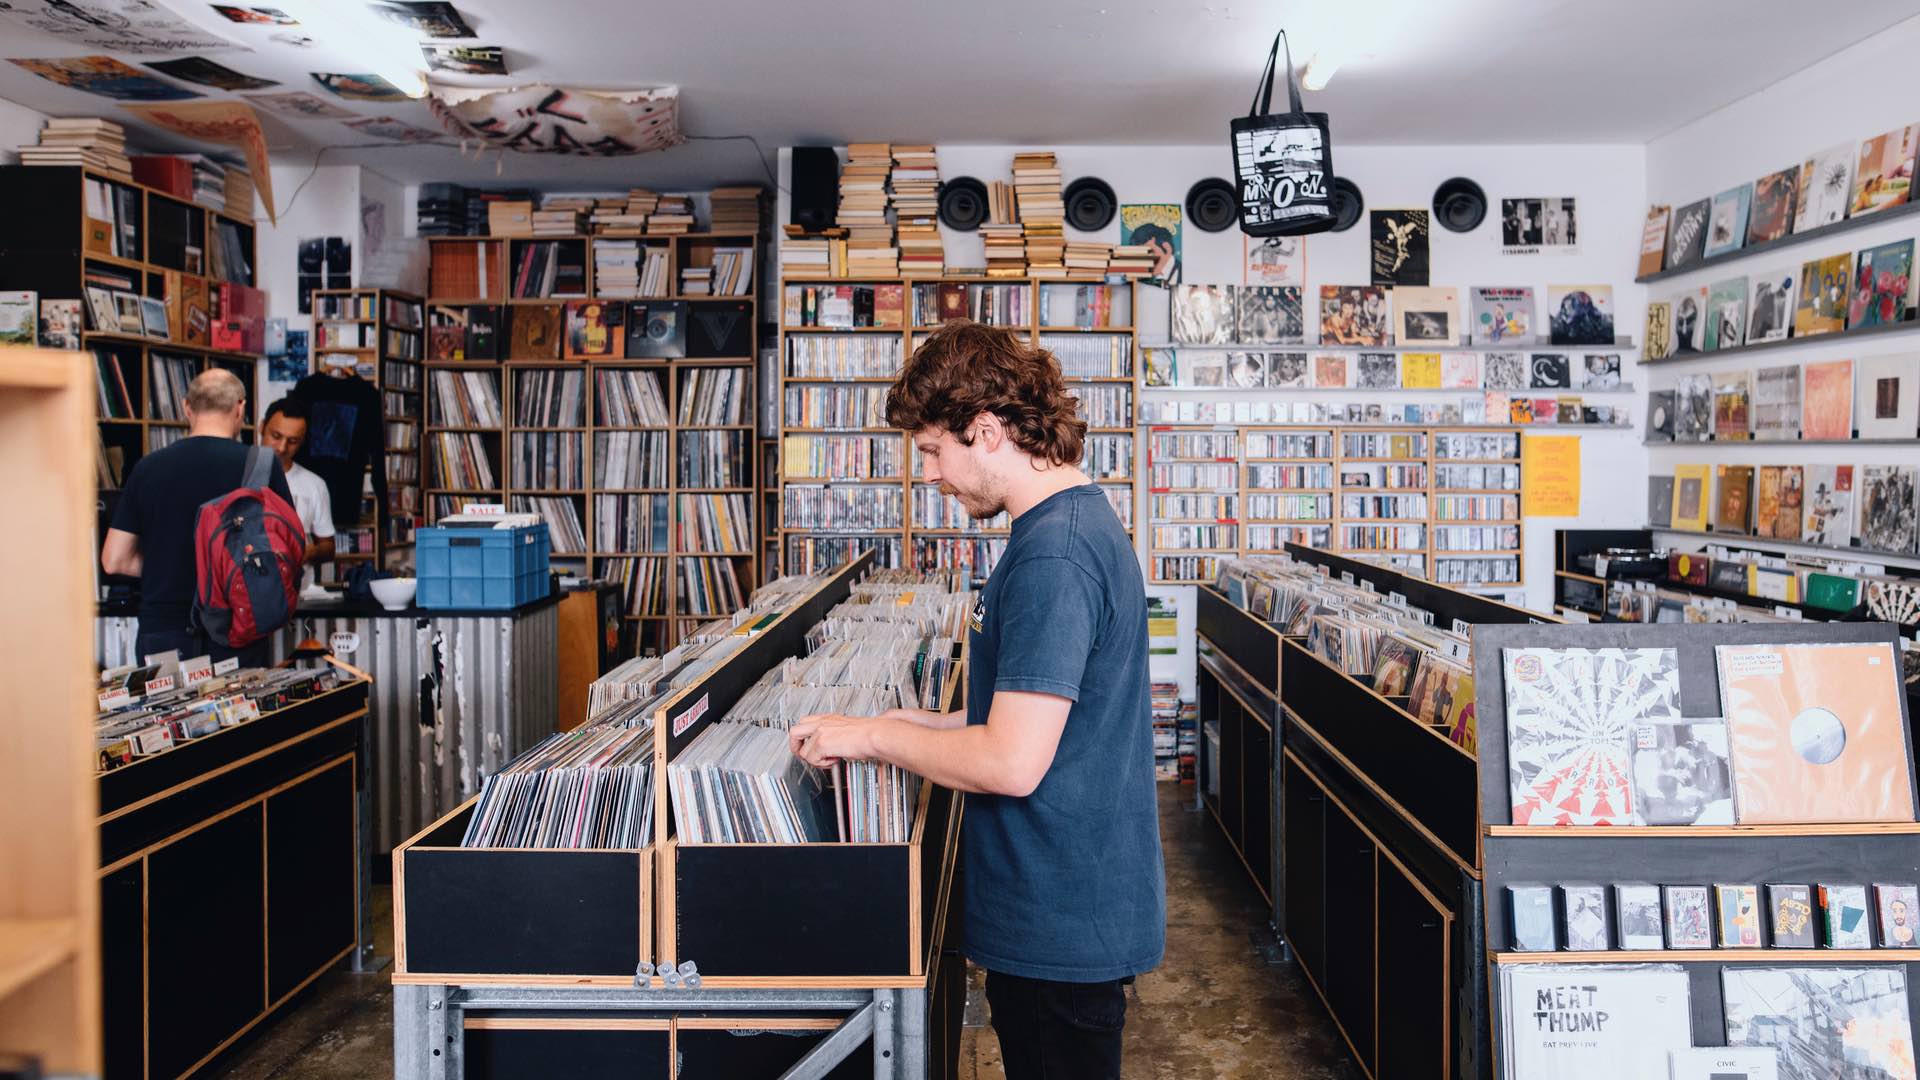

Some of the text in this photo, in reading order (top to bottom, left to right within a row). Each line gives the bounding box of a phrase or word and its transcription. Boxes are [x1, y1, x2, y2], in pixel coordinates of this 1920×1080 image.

[1452, 644, 1458, 657] R
[188, 667, 213, 682] PUNK
[147, 677, 173, 691] METAL
[675, 713, 689, 734] JUST
[1537, 985, 1598, 1011] MEAT
[1533, 1010, 1610, 1033] THUMP
[1716, 1060, 1737, 1068] CIVIC
